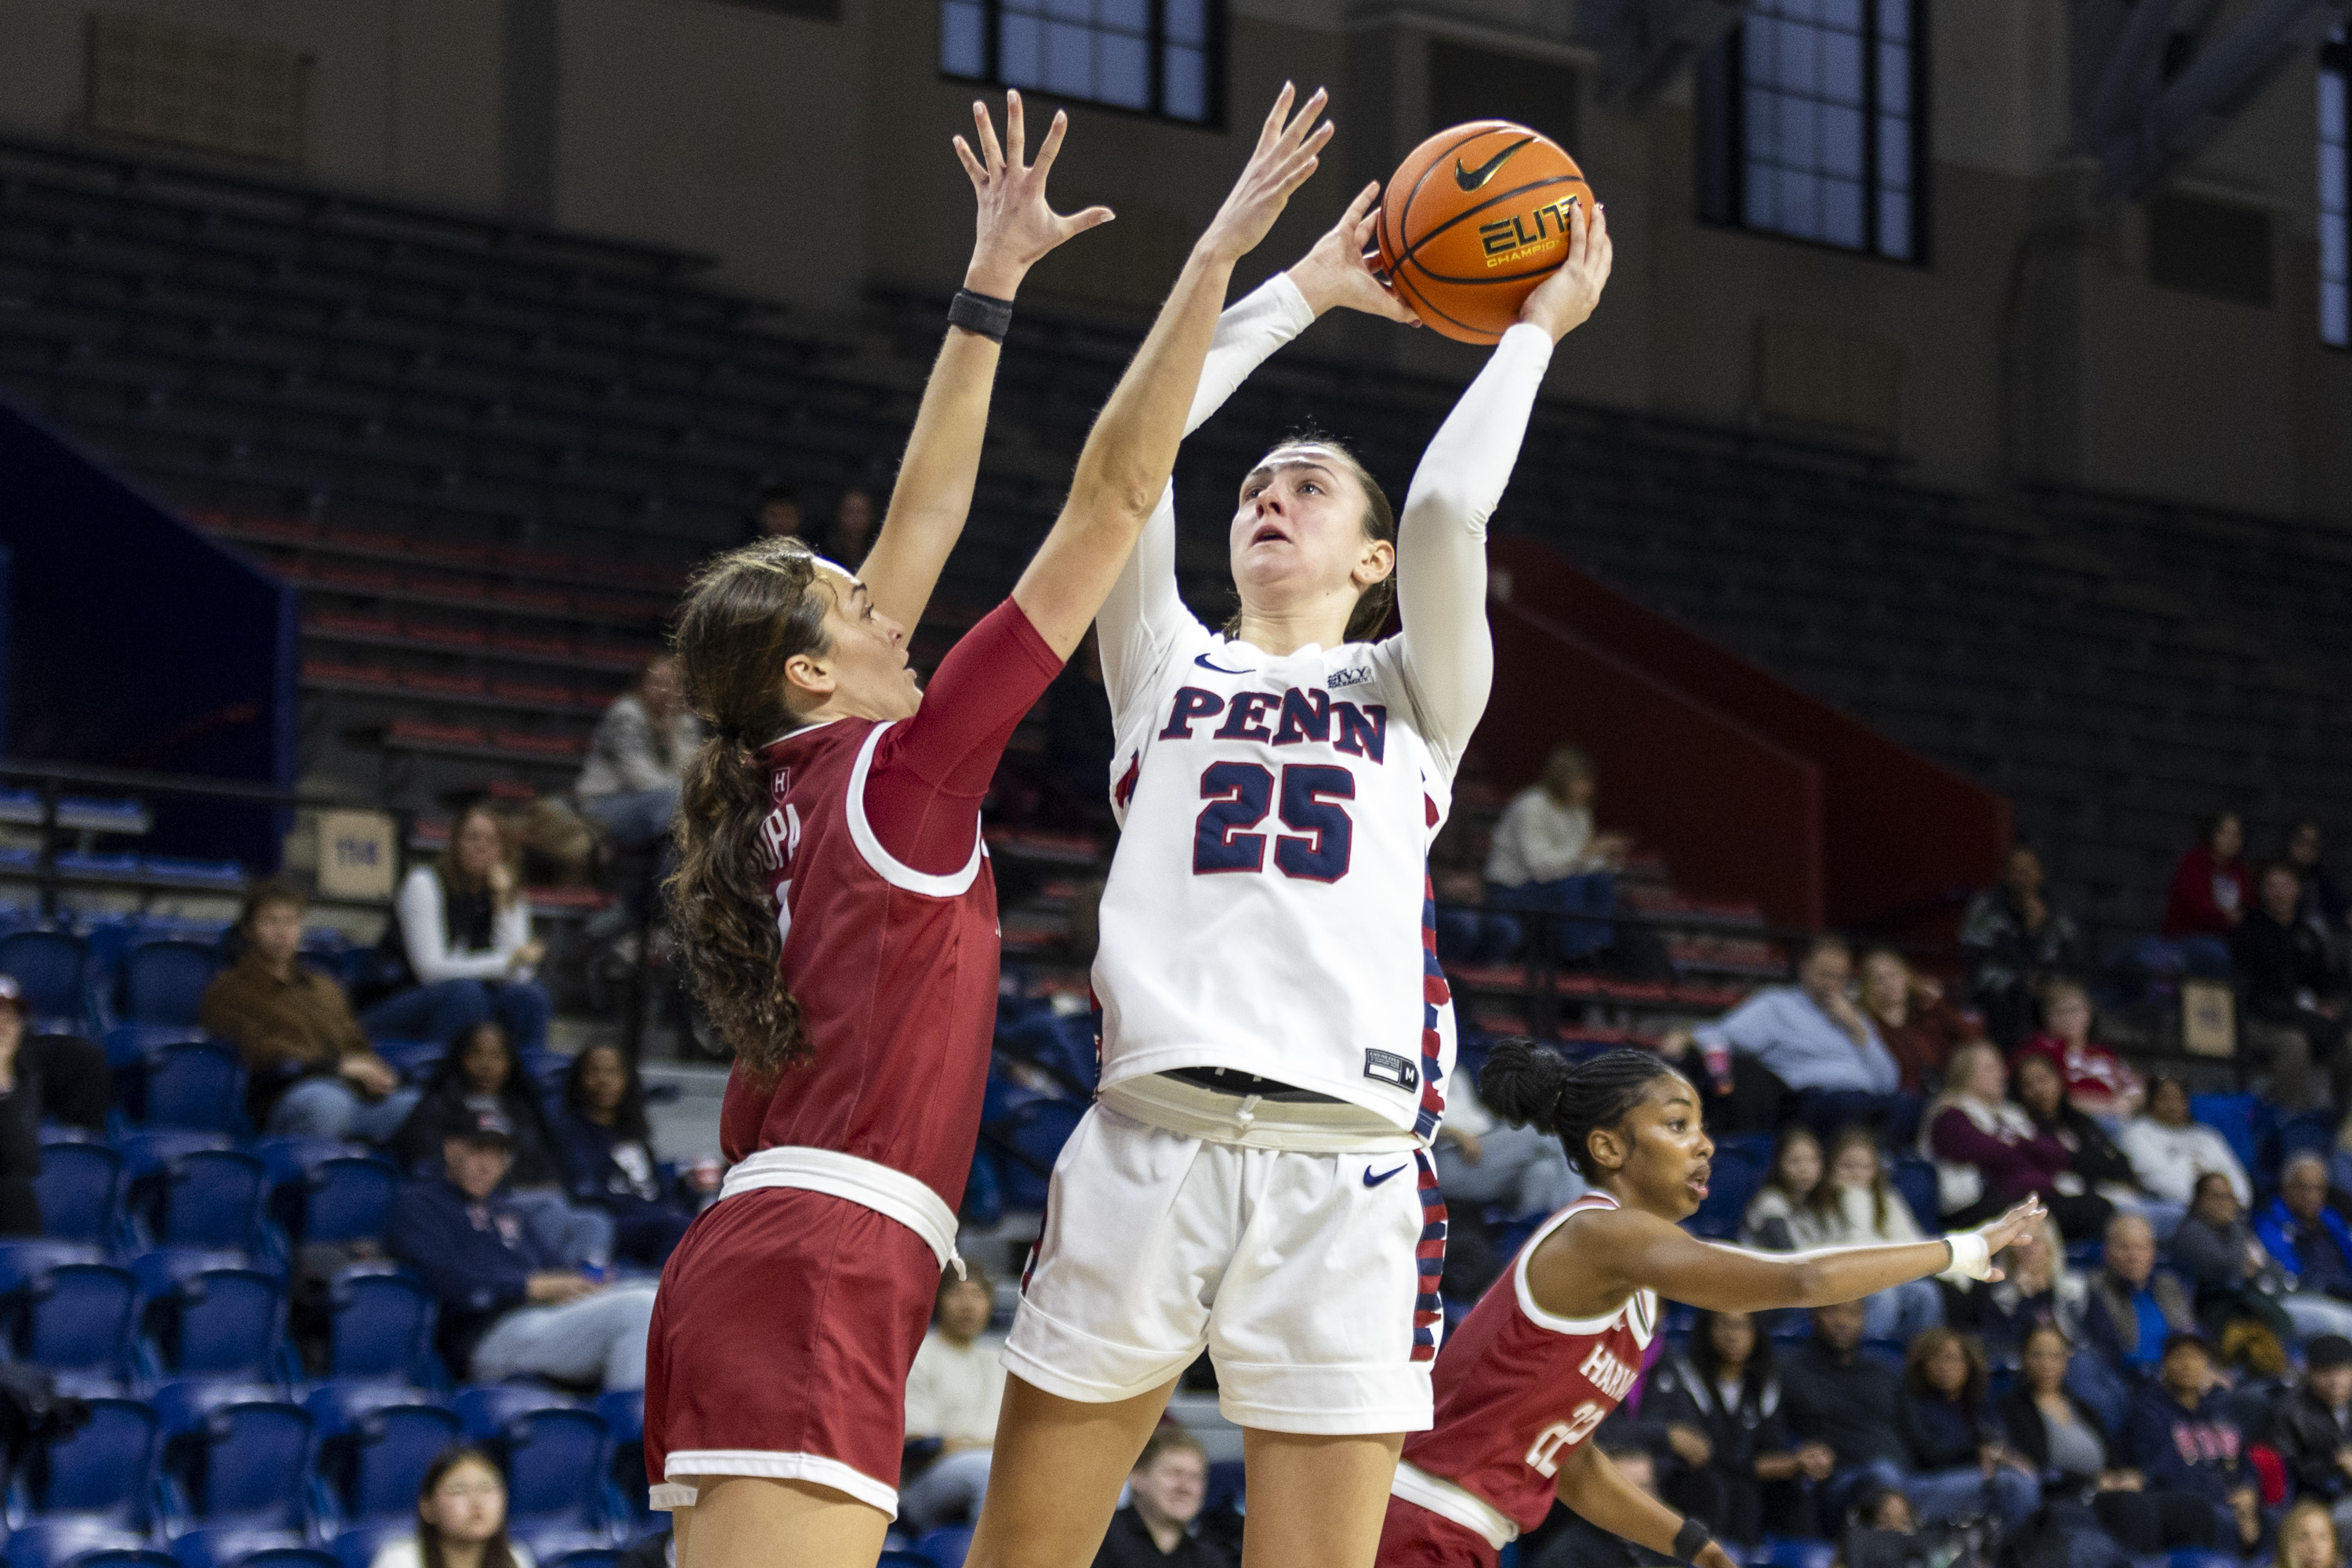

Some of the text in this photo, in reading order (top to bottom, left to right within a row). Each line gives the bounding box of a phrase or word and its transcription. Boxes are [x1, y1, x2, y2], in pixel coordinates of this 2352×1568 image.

[1486, 239, 1560, 268] CHAMPIO
[1337, 666, 1367, 684] IVY
[1158, 686, 1387, 765] PENN
[775, 771, 786, 793] H
[1192, 760, 1356, 884] 25
[1405, 1066, 1414, 1083] M
[1525, 1404, 1606, 1479] 22
